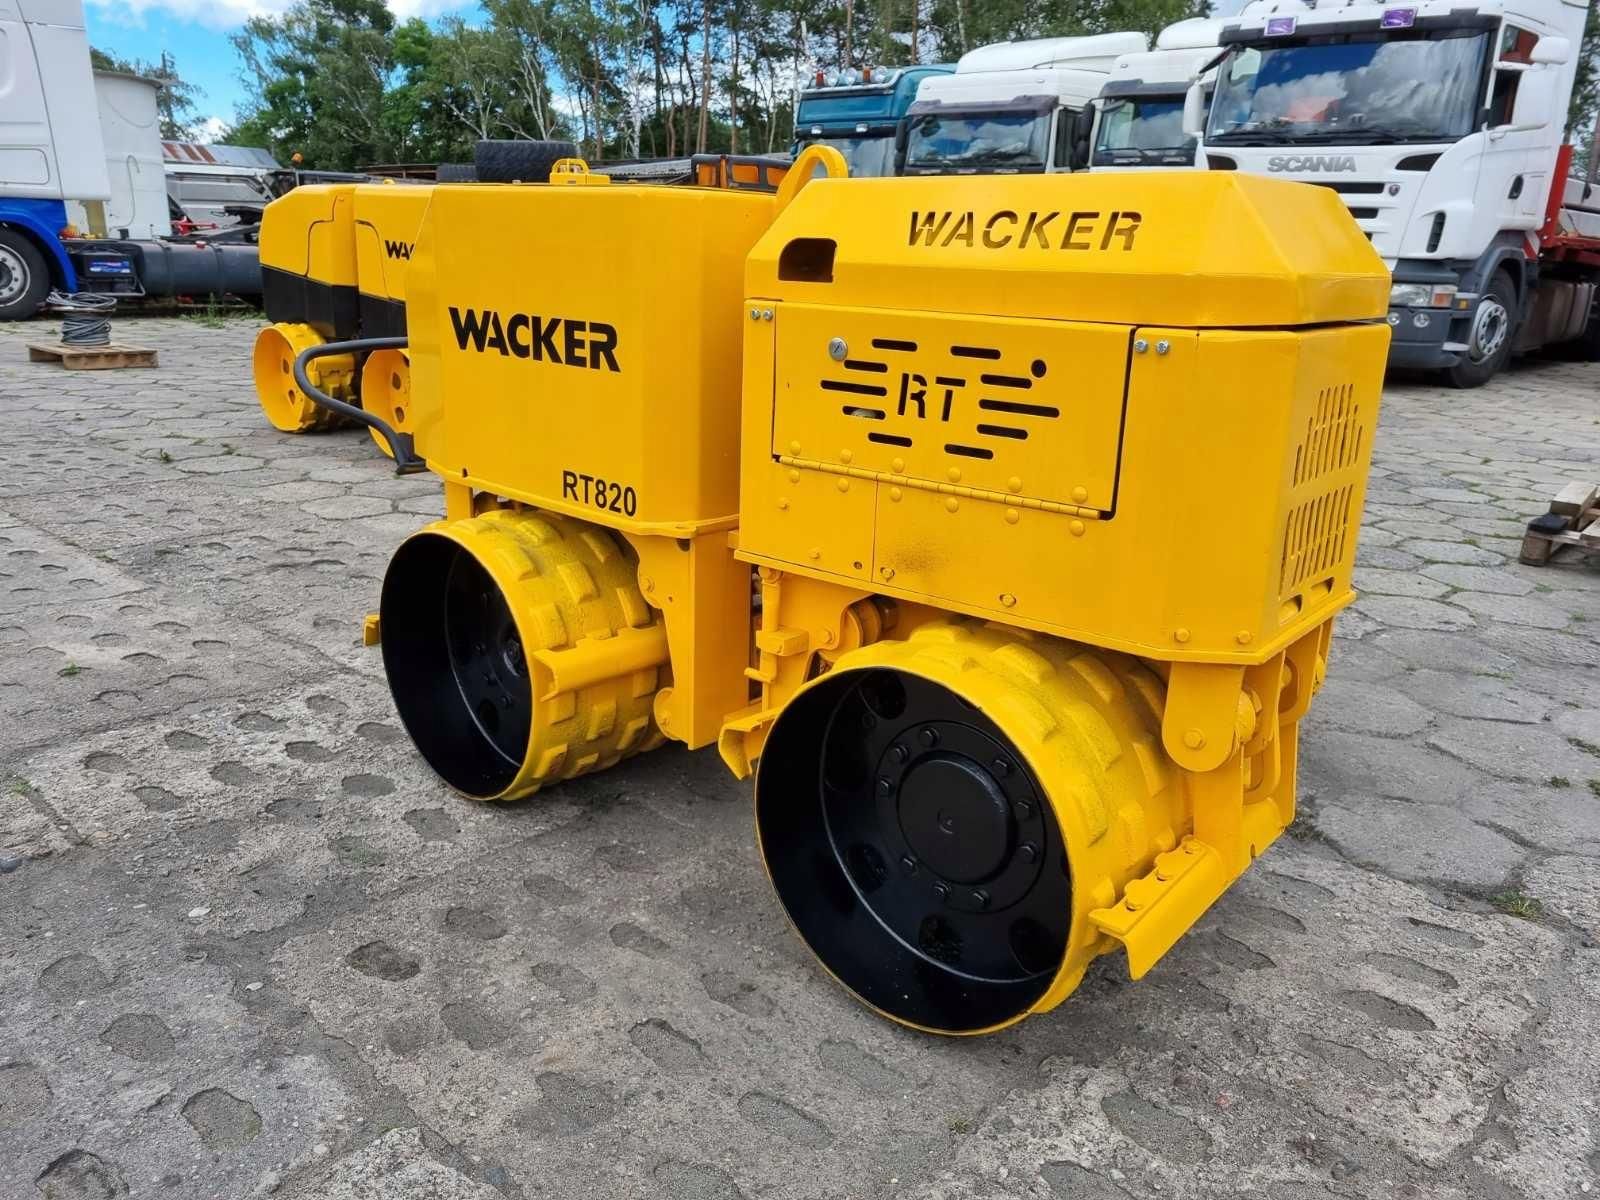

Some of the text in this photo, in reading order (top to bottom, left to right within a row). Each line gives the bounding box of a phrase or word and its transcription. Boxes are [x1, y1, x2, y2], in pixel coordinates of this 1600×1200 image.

[1267, 155, 1356, 173] SCANIA
[384, 239, 415, 261] WA
[909, 210, 1143, 251] WACKER
[448, 306, 621, 373] WACKER
[897, 372, 967, 422] RT
[562, 470, 637, 516] RT820
